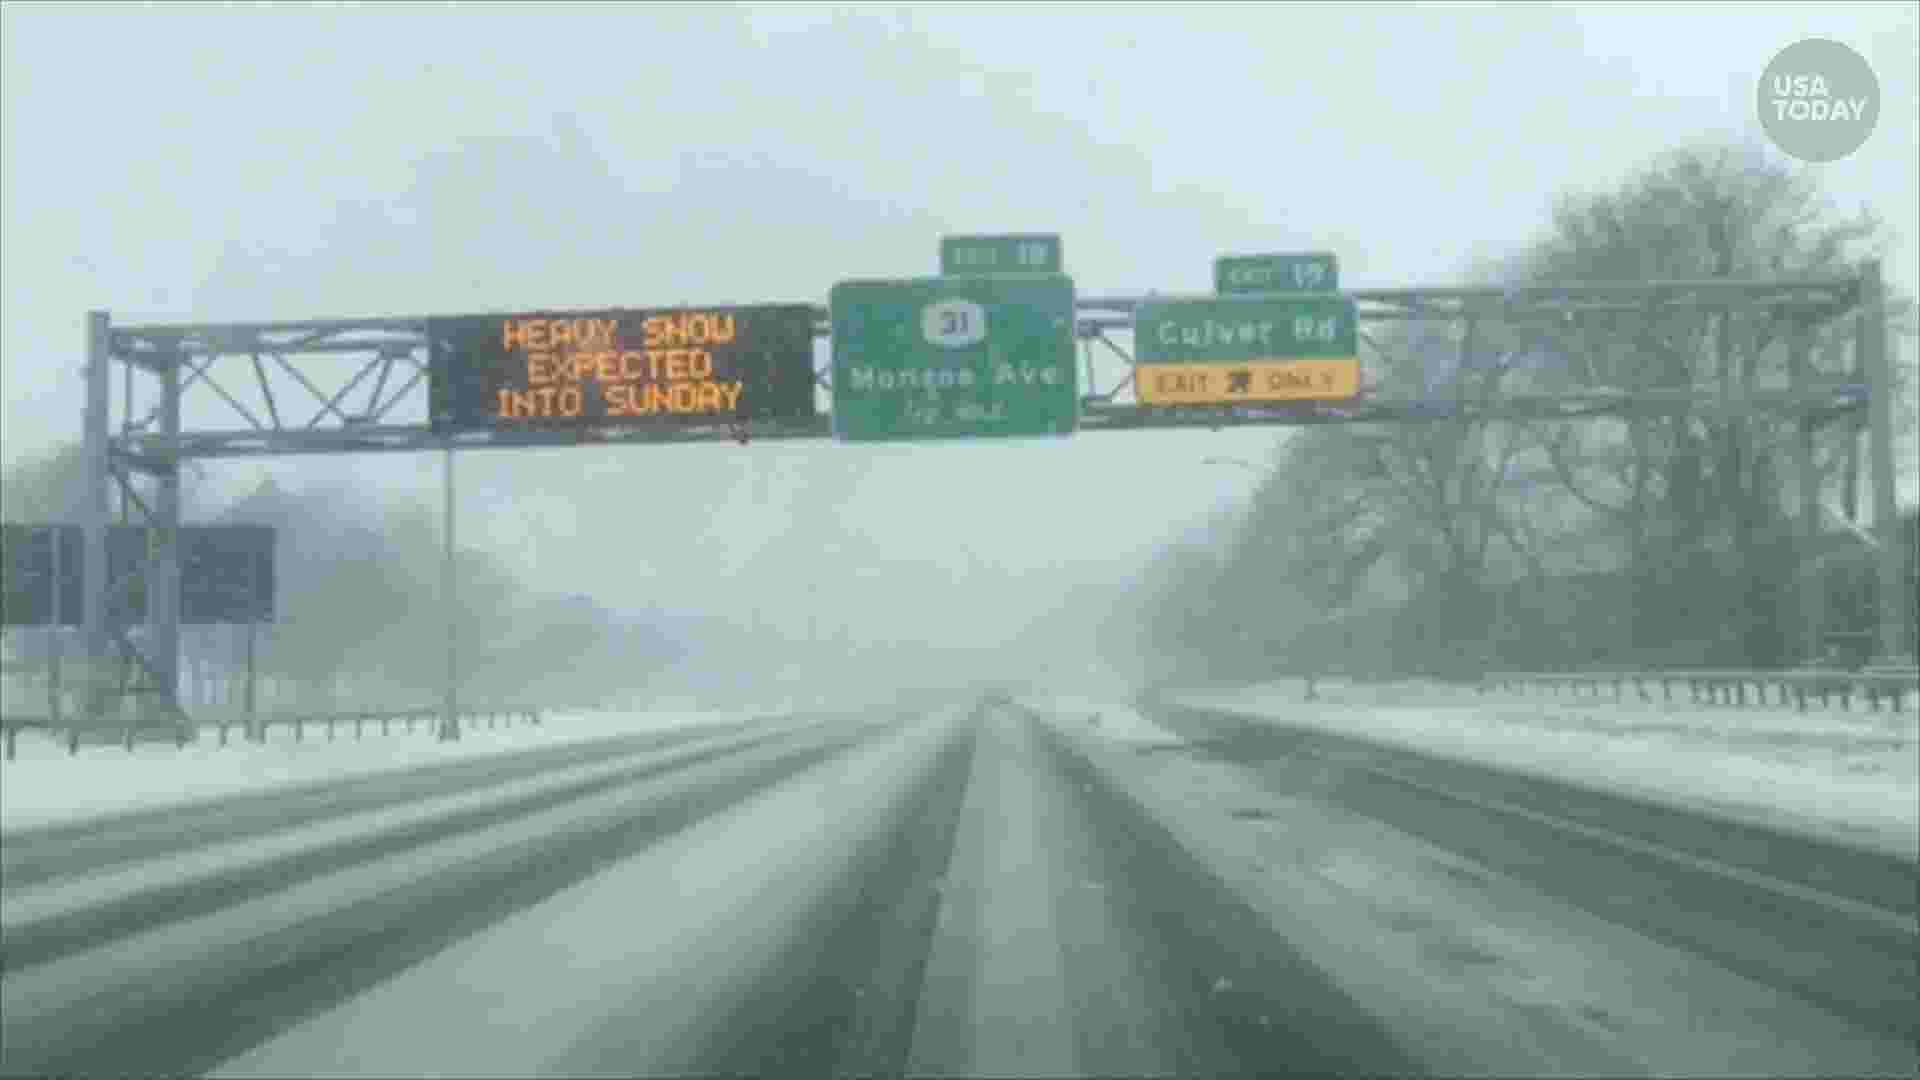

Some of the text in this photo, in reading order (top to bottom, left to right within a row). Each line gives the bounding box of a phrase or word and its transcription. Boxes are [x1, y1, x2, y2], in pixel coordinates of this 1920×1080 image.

[942, 310, 969, 335] 31
[1158, 315, 1336, 346] Culver Rd
[528, 350, 712, 384] EXPECTED
[994, 360, 1064, 386] Ave
[497, 380, 744, 417] INTO SUNDAY
